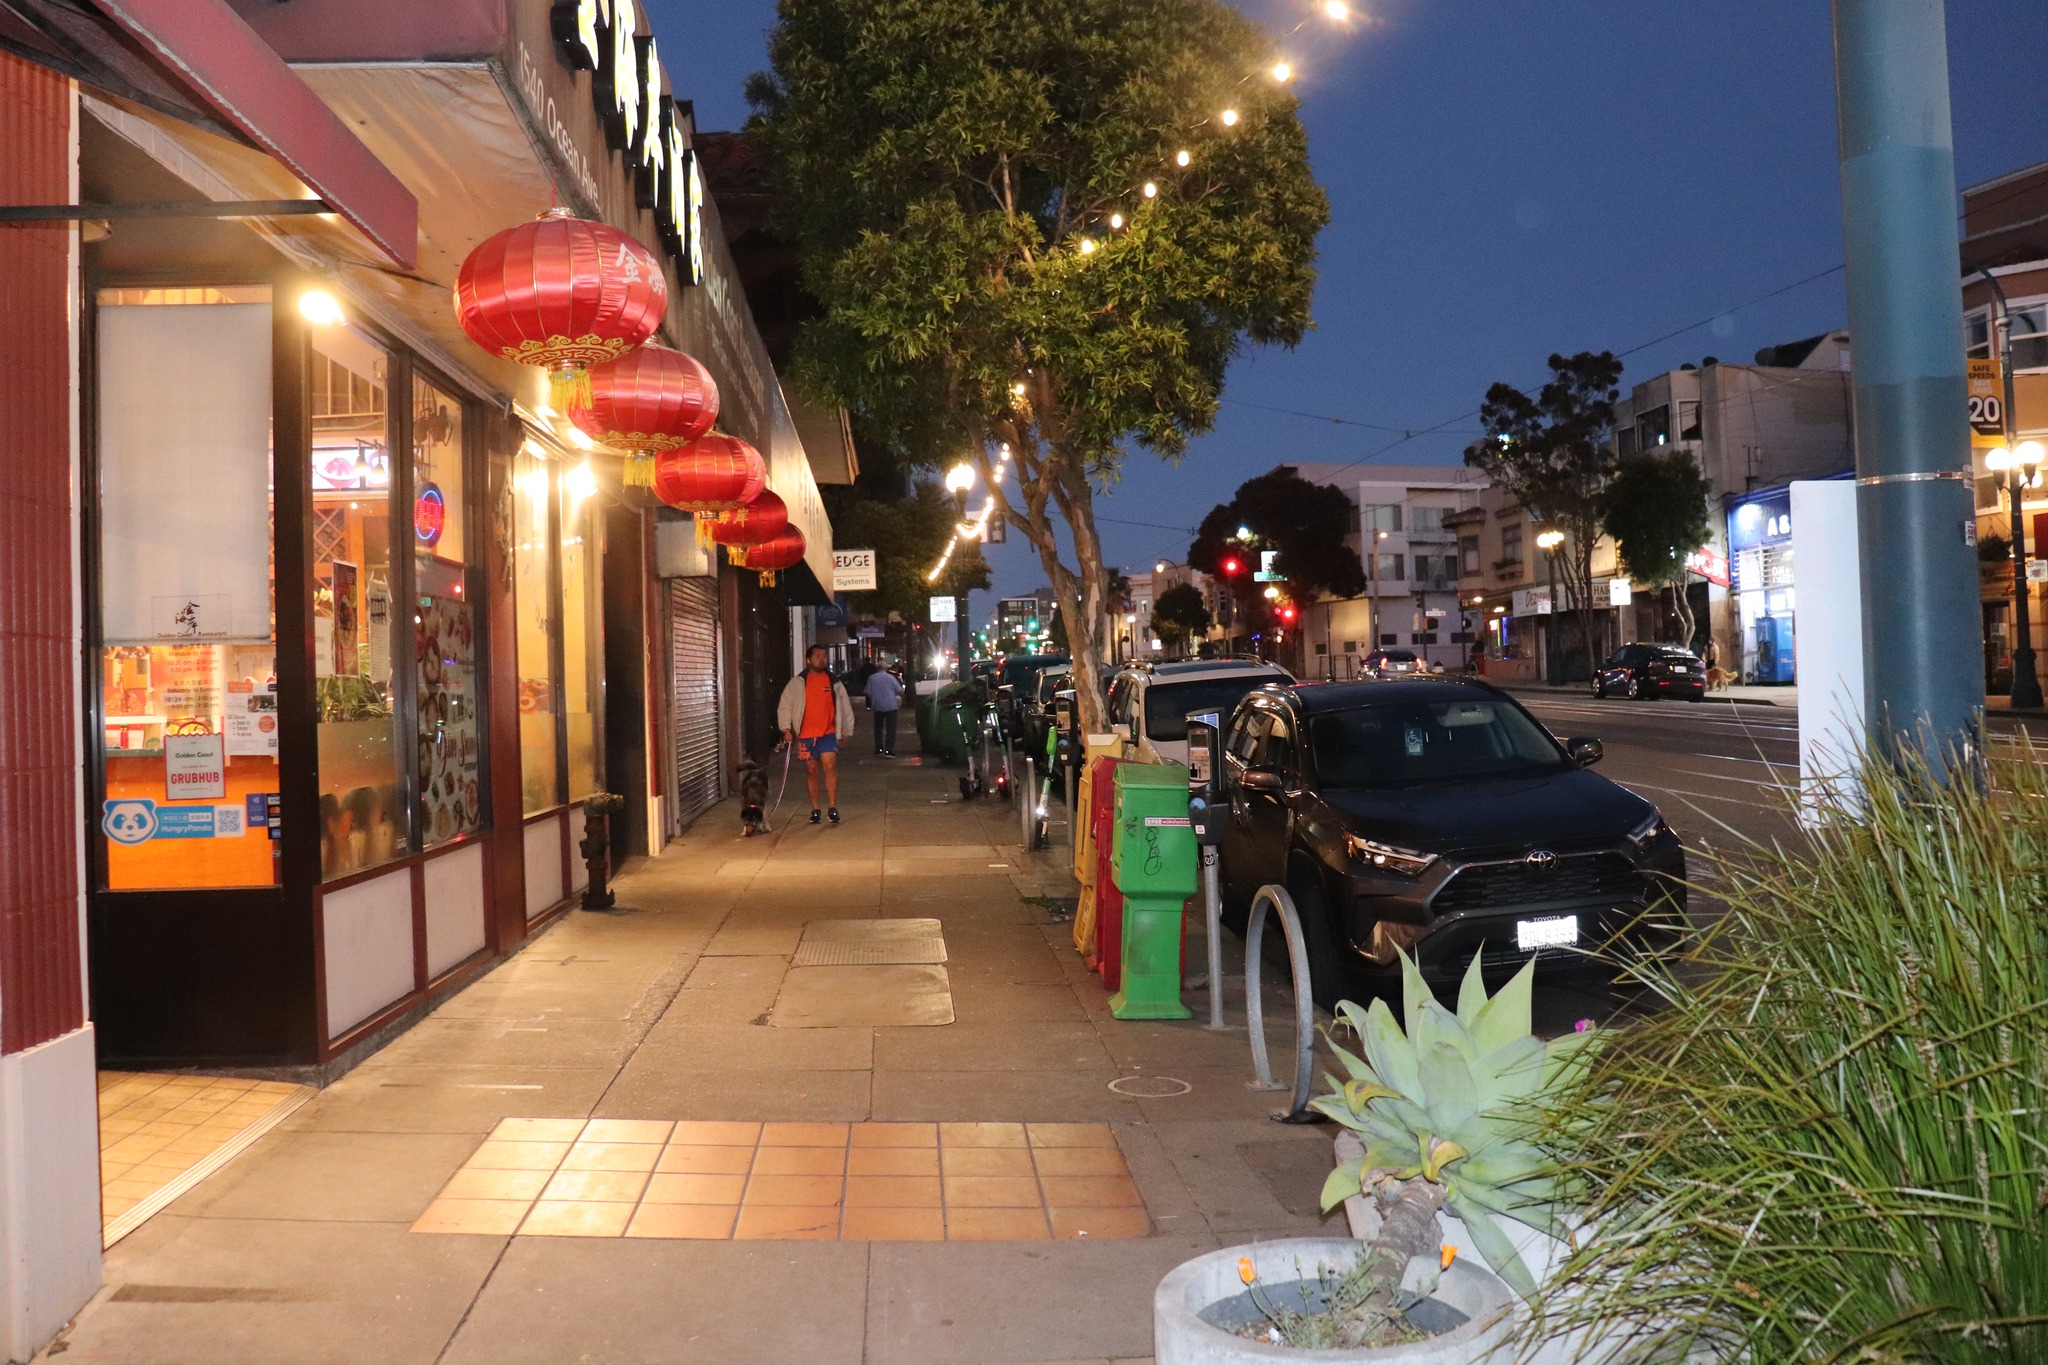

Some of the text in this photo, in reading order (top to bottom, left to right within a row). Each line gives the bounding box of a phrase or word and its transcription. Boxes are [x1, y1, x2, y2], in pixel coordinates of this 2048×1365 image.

[519, 41, 545, 119] 1540
[547, 97, 580, 179] Ocean
[577, 0, 704, 286] 海岸酒家
[1968, 372, 1996, 380] SPEEDS
[1968, 396, 2000, 423] 20
[836, 578, 870, 586] Systems
[171, 771, 220, 784] GRUBHUB
[161, 824, 213, 834] HungryPanda
[1533, 915, 1561, 923] TOYOTA
